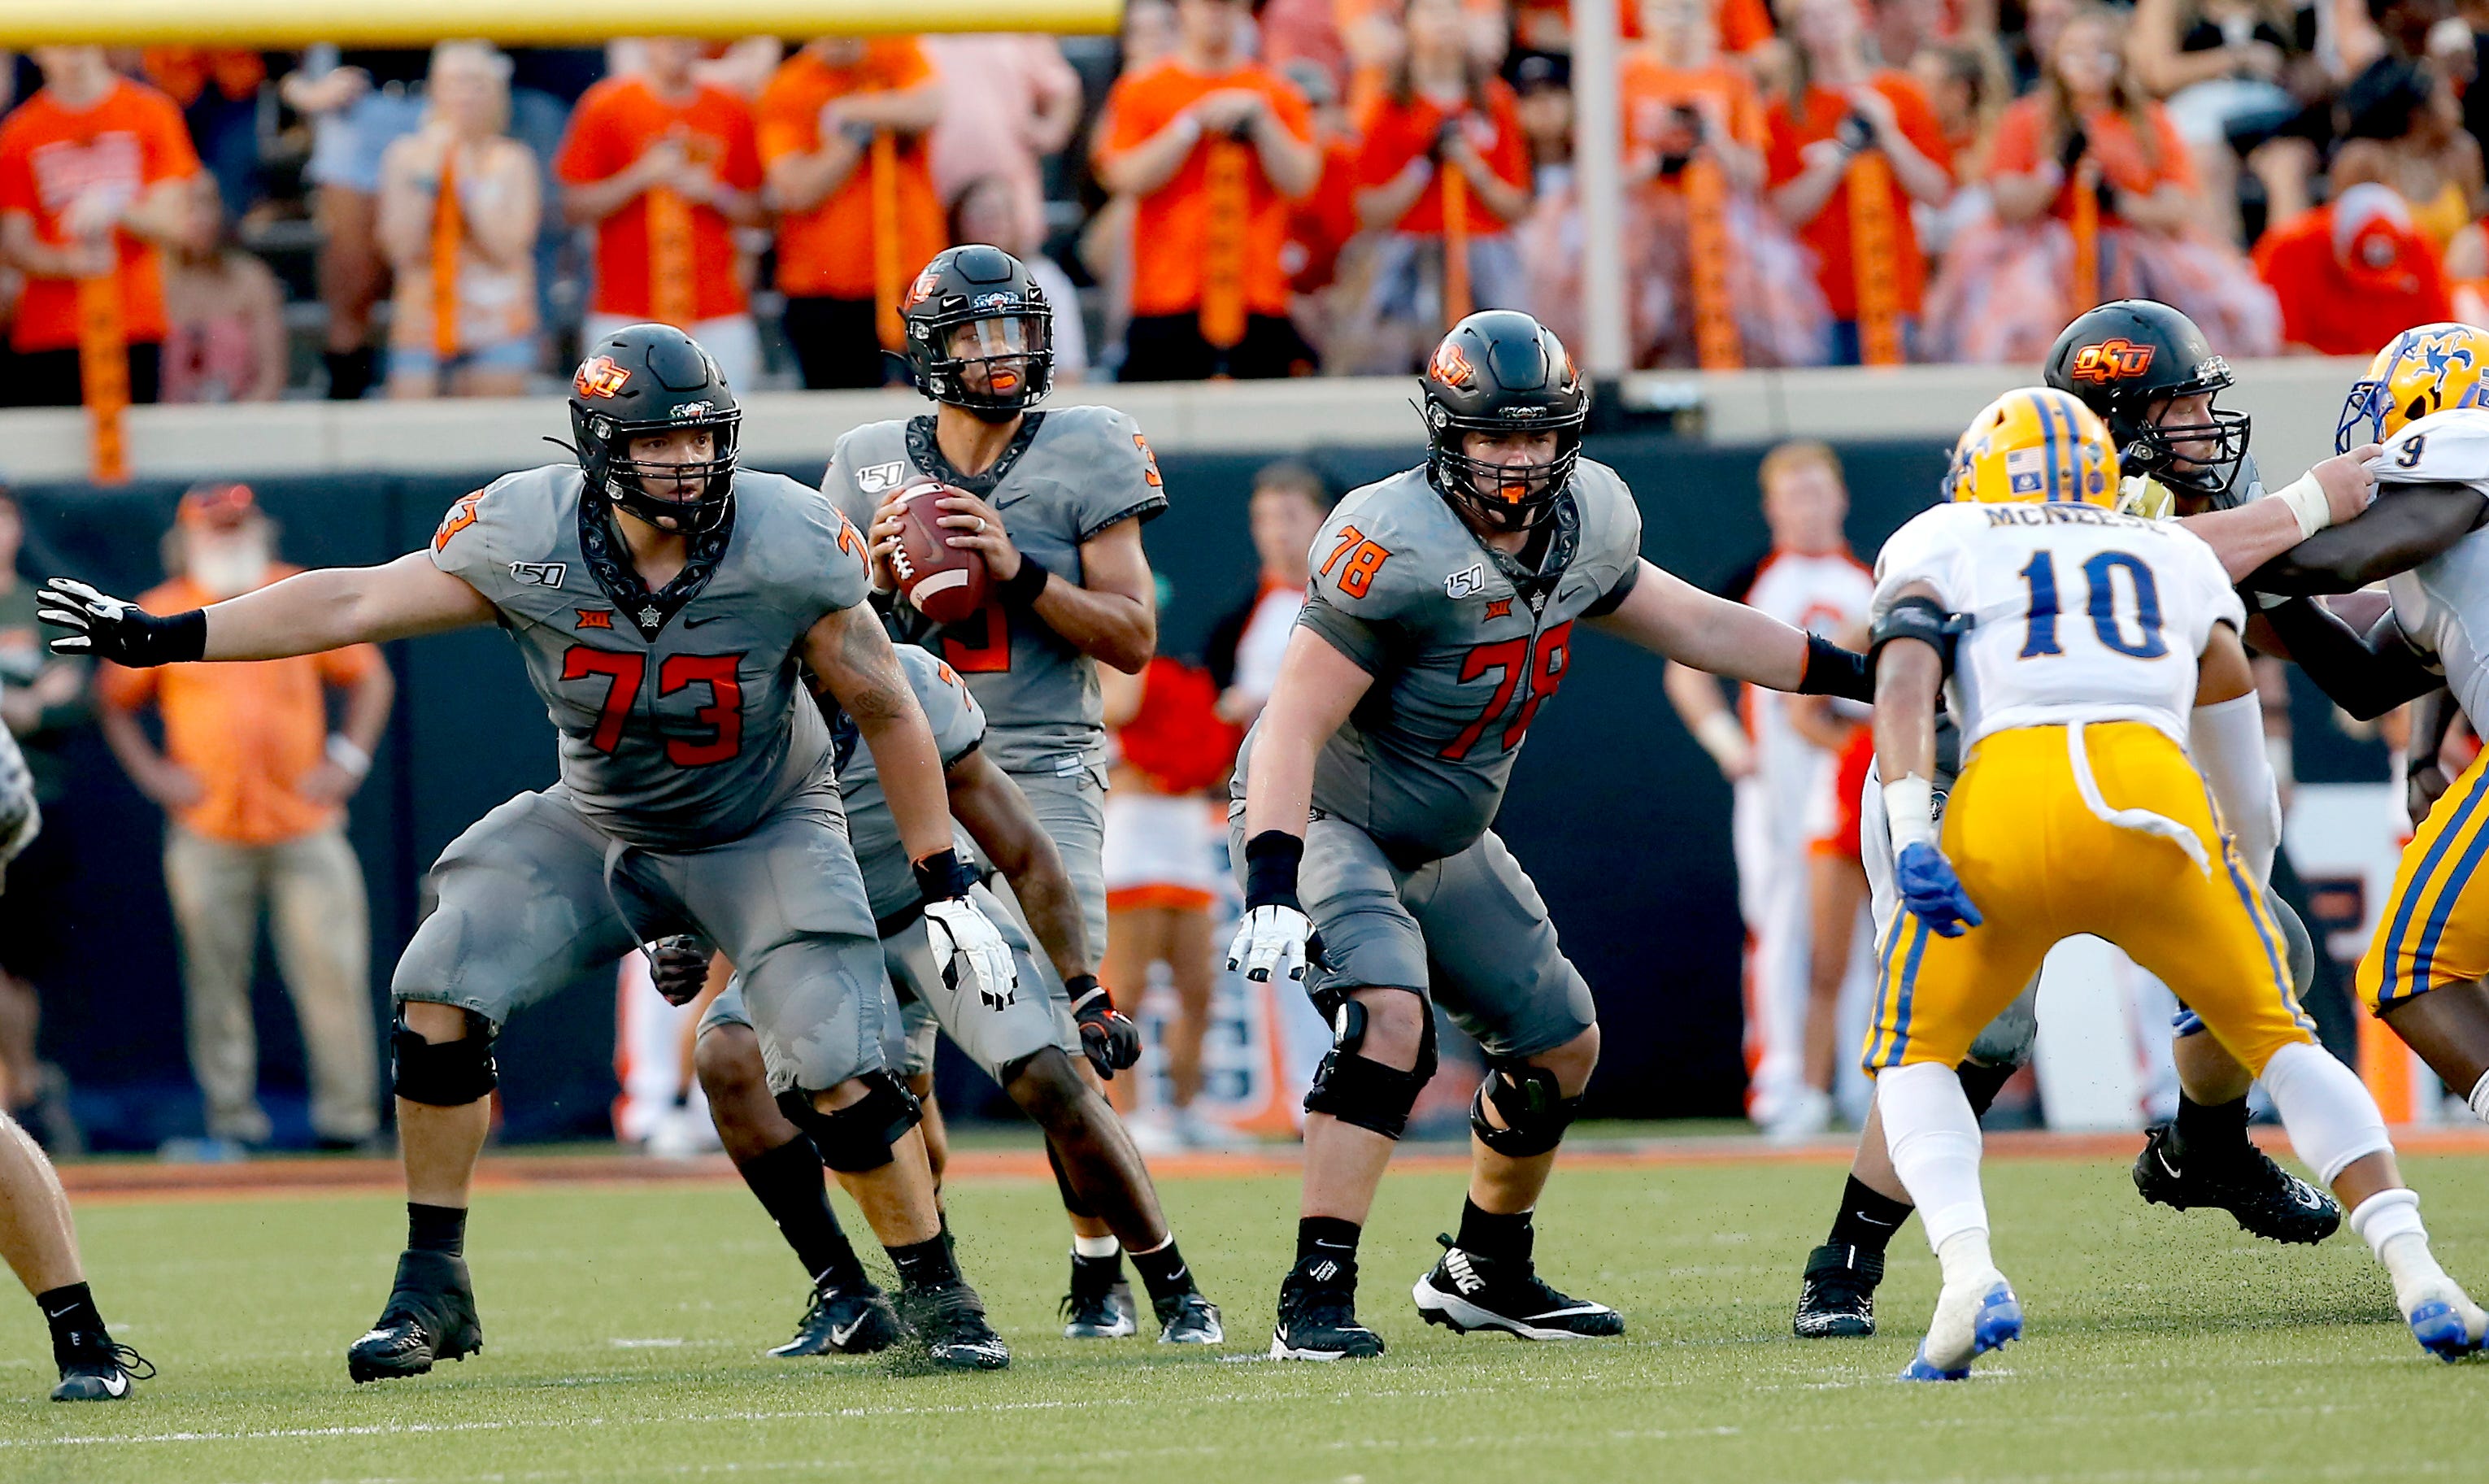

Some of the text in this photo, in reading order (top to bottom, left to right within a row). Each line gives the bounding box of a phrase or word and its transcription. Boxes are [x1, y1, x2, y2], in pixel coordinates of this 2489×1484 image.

[2073, 337, 2156, 385] OSU
[2397, 436, 2427, 469] 9
[1319, 525, 1394, 600] 78
[2017, 549, 2172, 661] 10
[559, 643, 749, 769] 73
[1435, 619, 1573, 759] 78
[1444, 1247, 1486, 1295] NIKE
